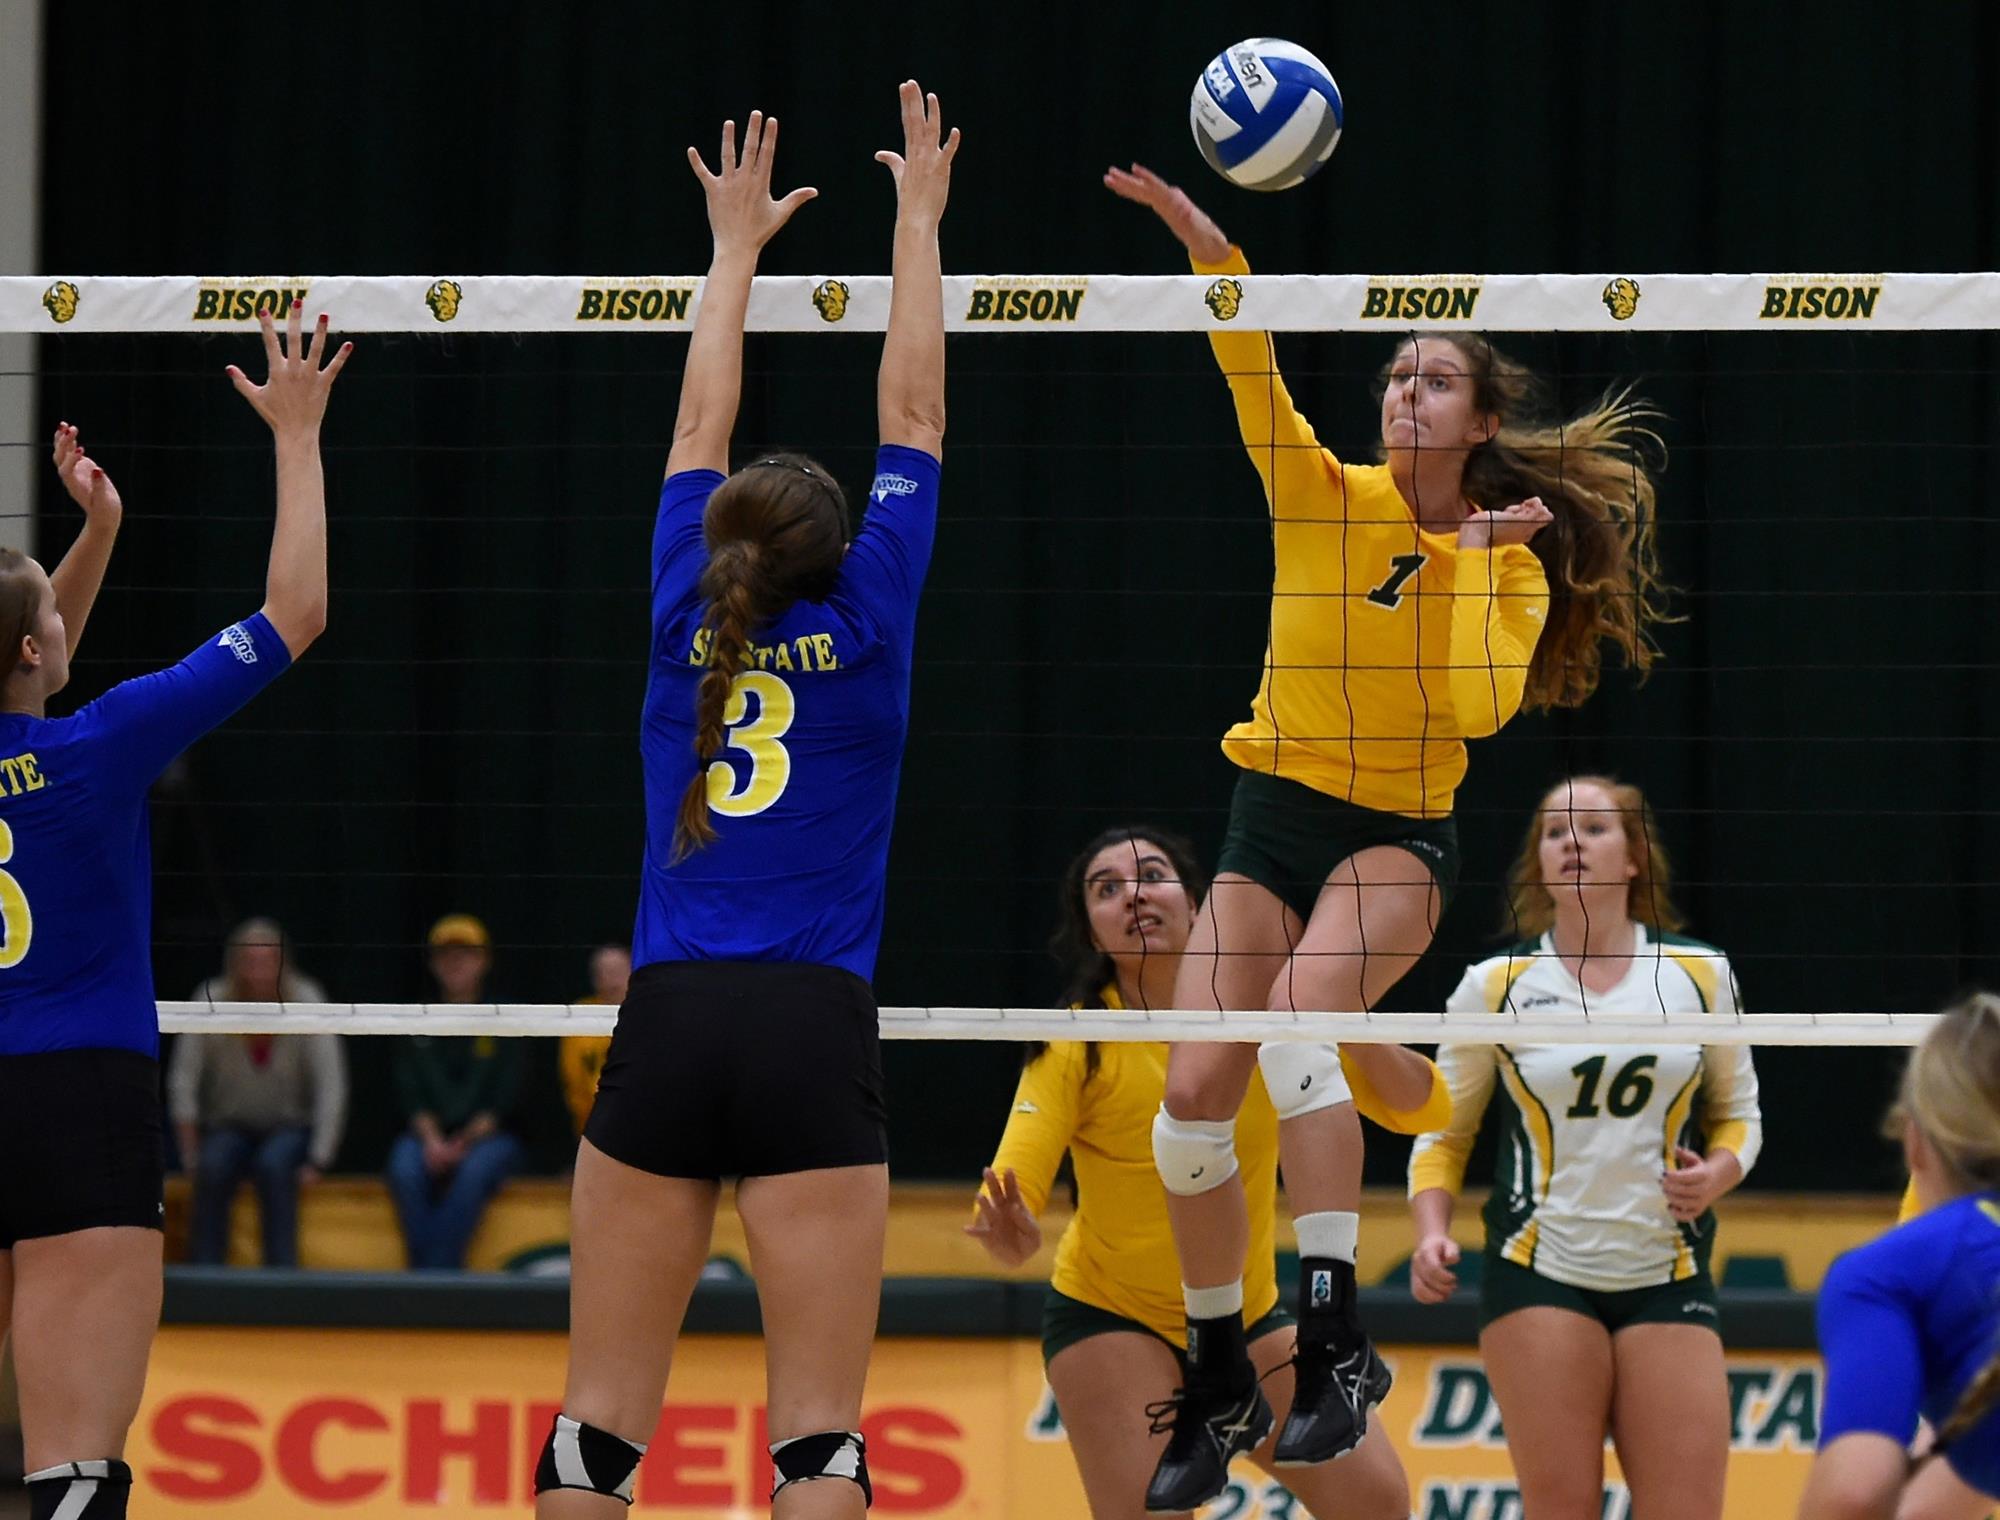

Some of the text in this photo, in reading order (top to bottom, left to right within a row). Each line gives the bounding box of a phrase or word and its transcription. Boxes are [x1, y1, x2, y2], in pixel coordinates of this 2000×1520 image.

[193, 288, 307, 321] BISON
[576, 288, 693, 321] BISON
[966, 288, 1085, 321] BISON
[1360, 286, 1480, 320] BISON
[1759, 286, 1880, 319] BISON
[1367, 552, 1430, 611] 1
[706, 671, 795, 817] 3
[1566, 1054, 1658, 1118] 16
[146, 1391, 967, 1514] SCHES
